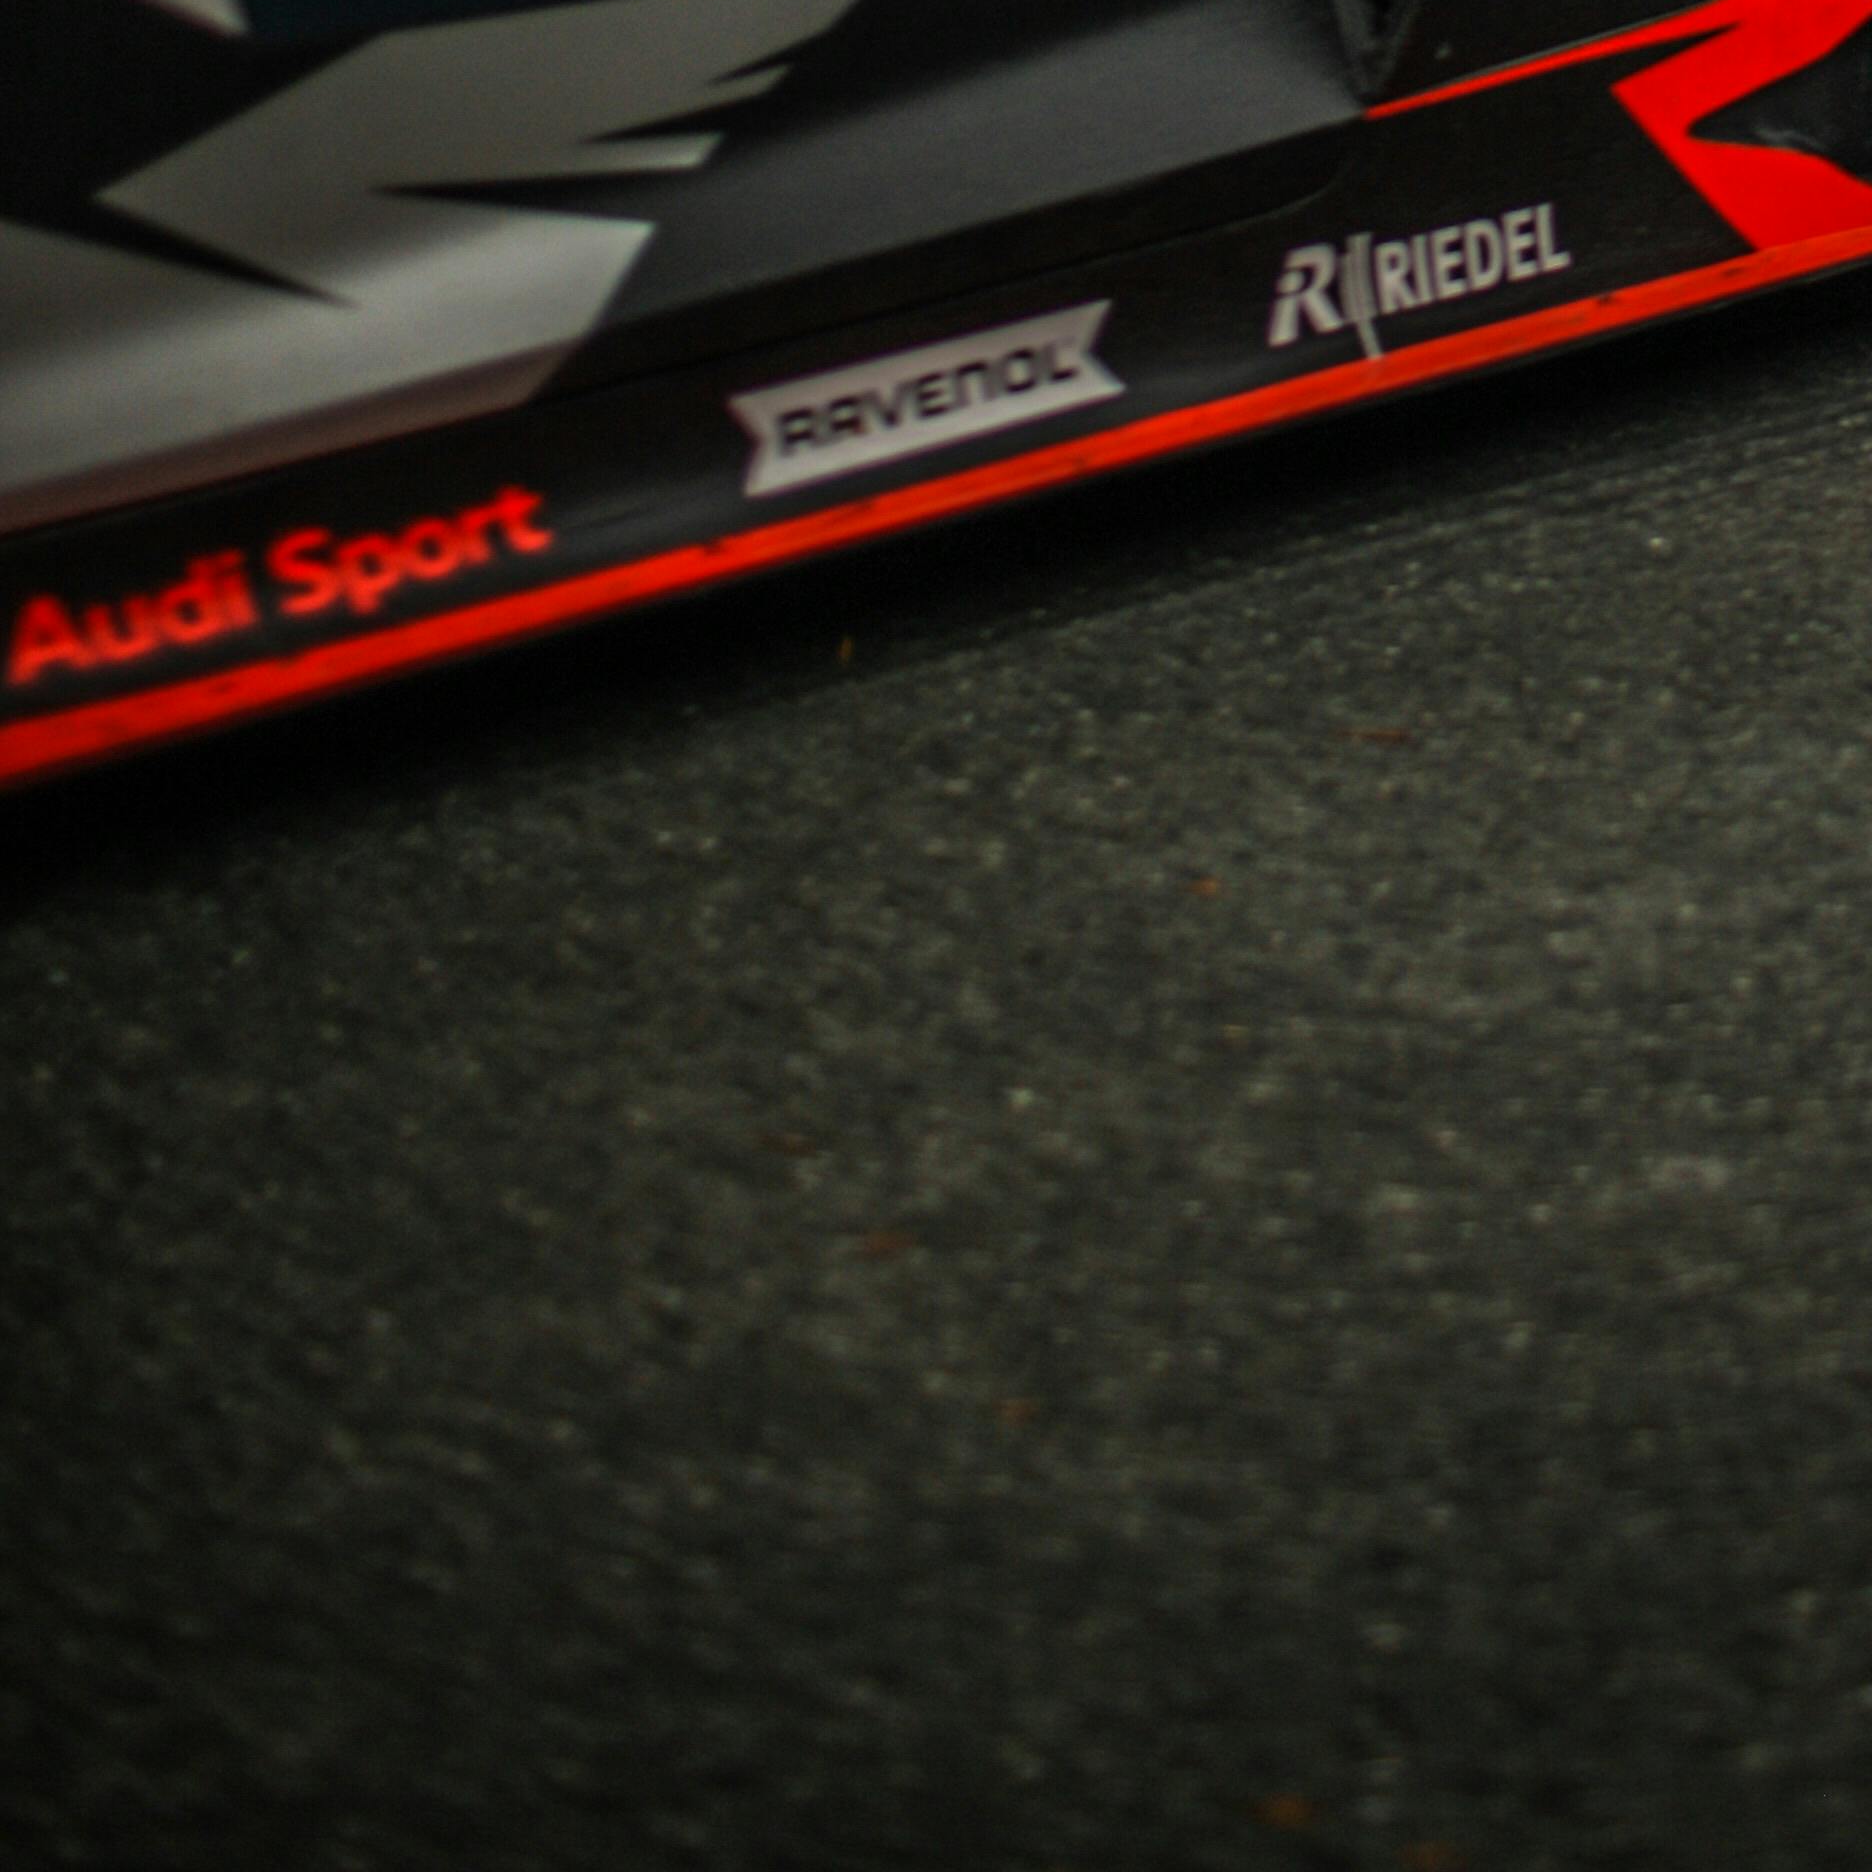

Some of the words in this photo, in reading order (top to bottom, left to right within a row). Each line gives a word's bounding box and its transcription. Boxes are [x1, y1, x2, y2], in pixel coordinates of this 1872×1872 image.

[1374, 202, 1571, 315] RIEDEL
[776, 343, 1079, 458] RAVENOL
[8, 549, 260, 687] Audi
[267, 486, 553, 616] Sport
